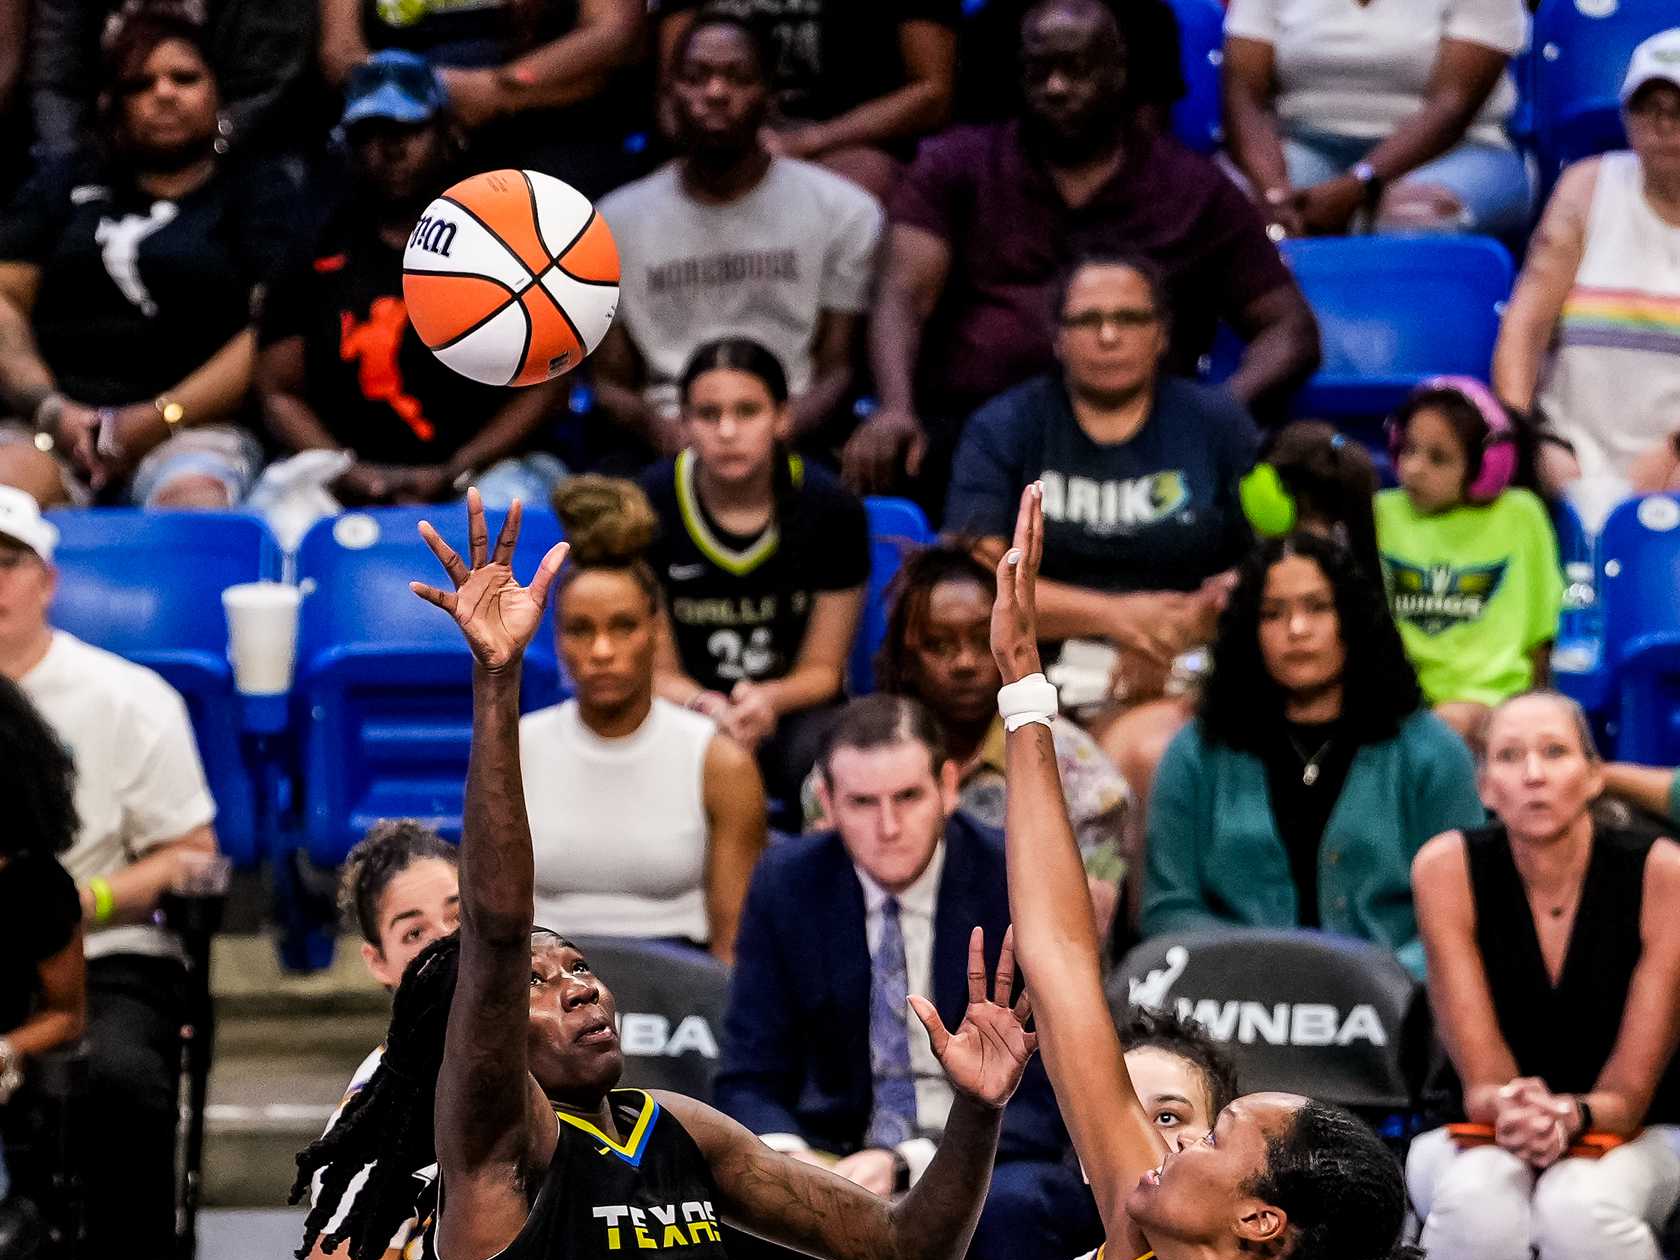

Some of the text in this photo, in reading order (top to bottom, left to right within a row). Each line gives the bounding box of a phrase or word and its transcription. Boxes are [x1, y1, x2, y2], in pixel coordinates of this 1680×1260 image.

[410, 216, 457, 257] Wil
[615, 1011, 720, 1058] BA
[1176, 997, 1387, 1046] WNBA
